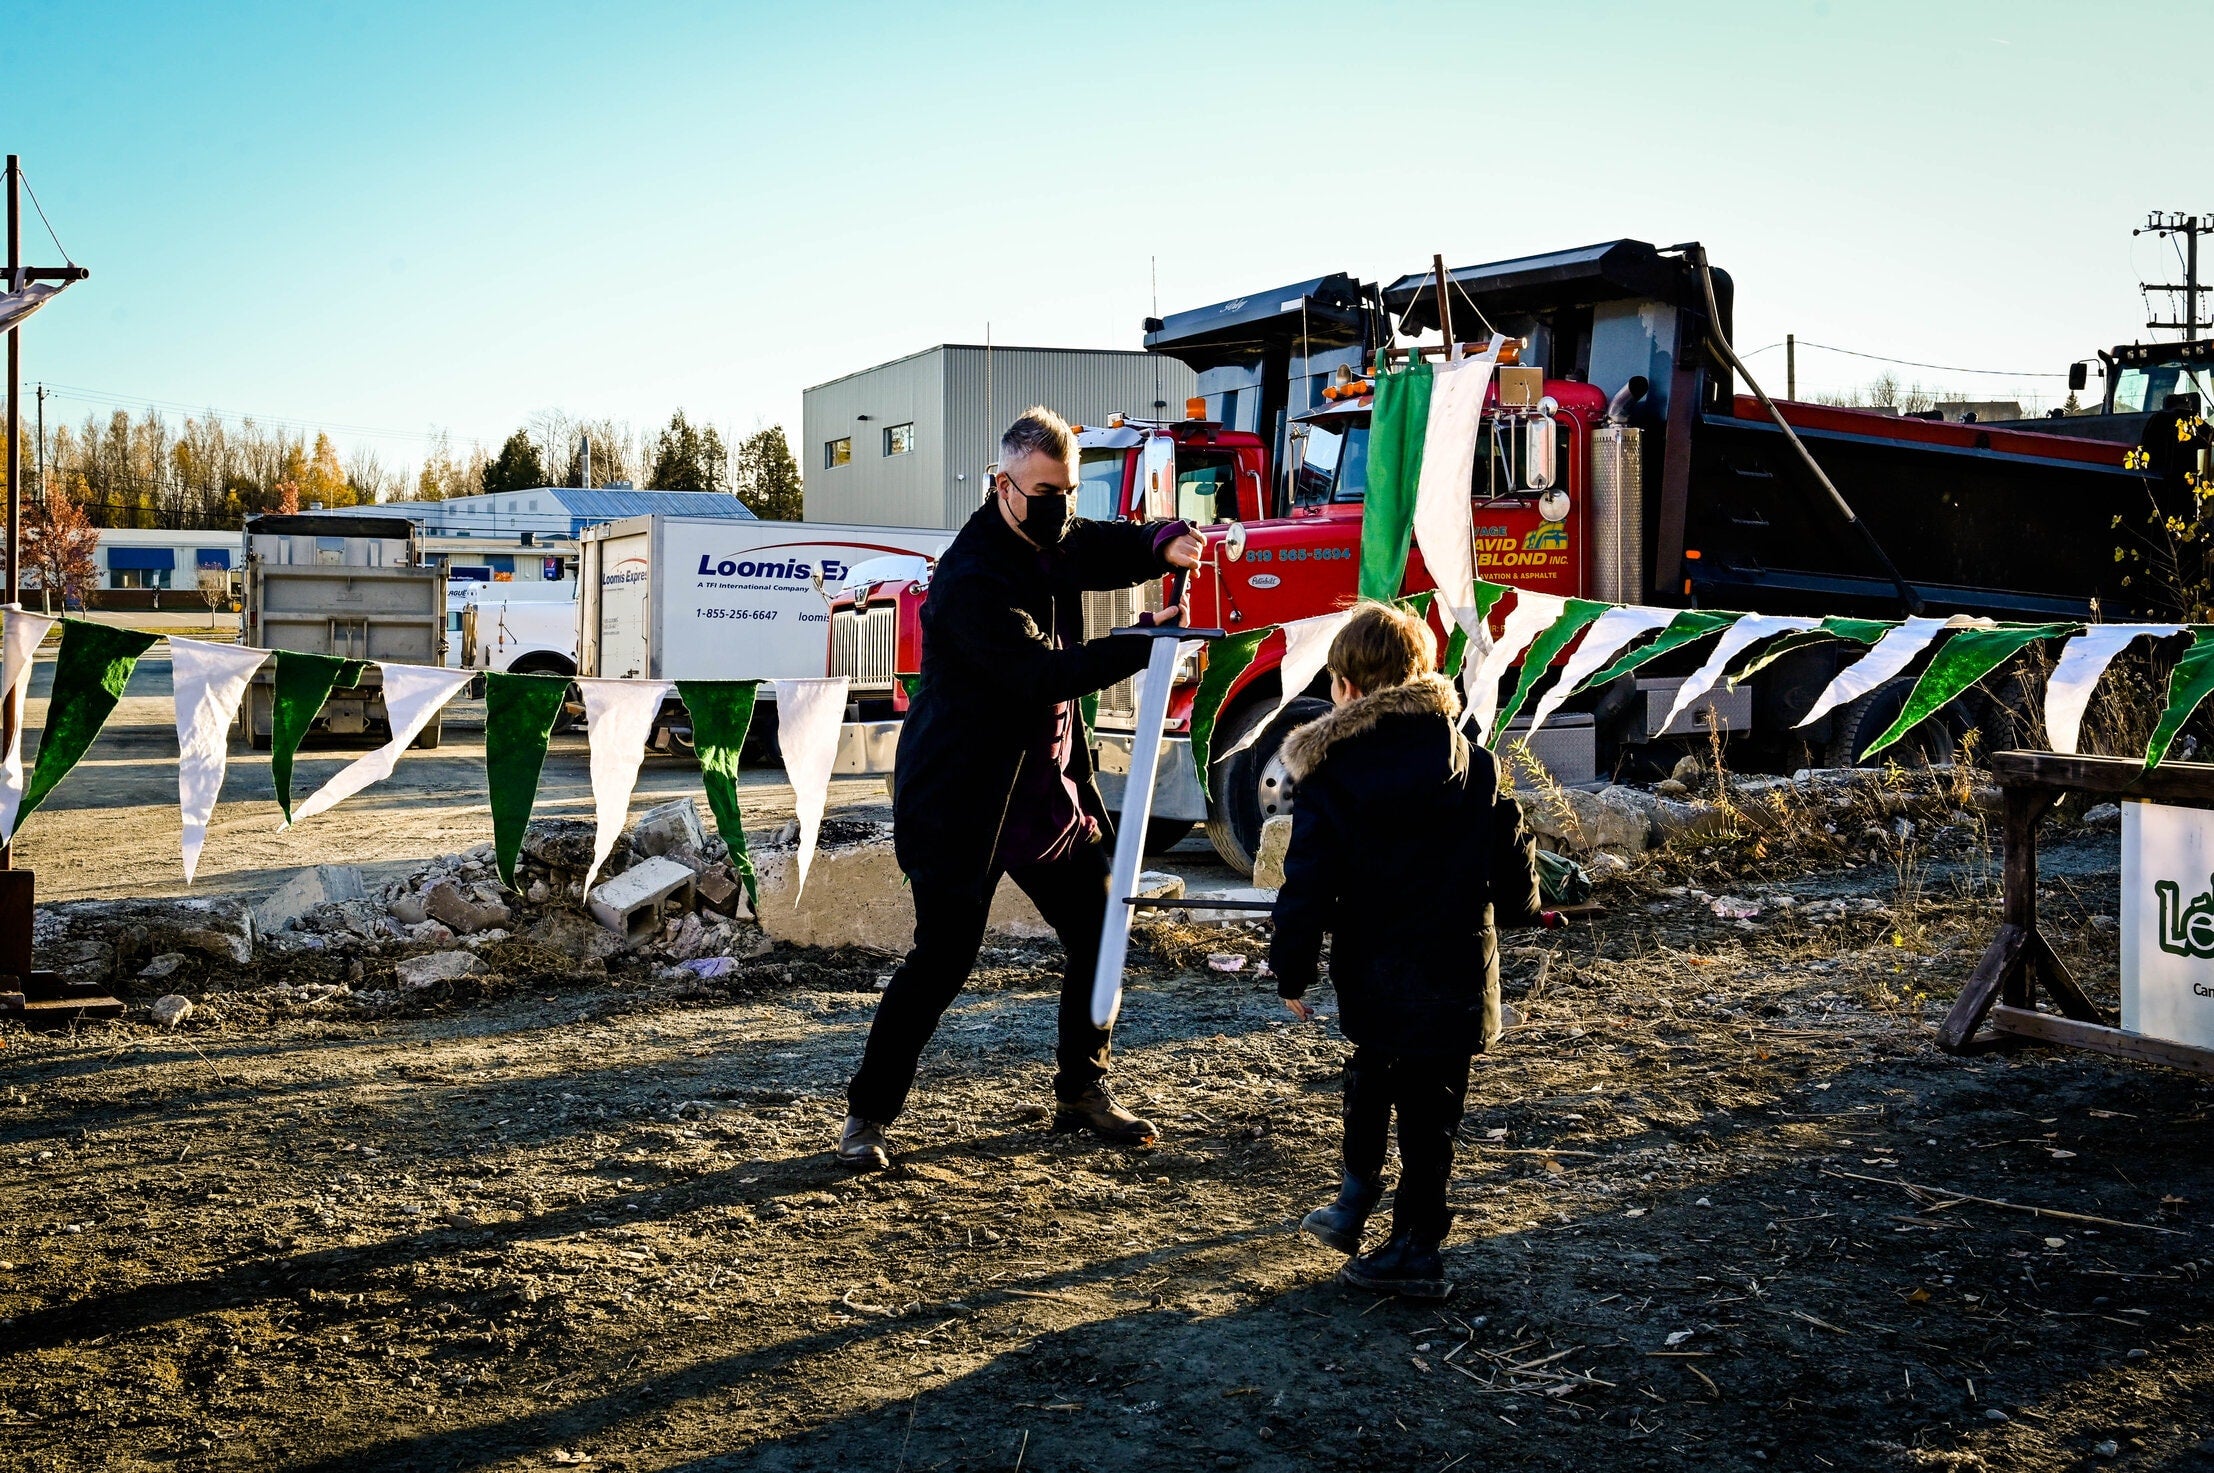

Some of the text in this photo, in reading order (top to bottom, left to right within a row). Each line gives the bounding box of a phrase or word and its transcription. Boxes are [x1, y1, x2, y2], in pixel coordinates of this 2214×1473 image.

[1474, 526, 1507, 536] VAGE
[1475, 538, 1517, 551] AVID
[1245, 548, 1351, 562] 819 565-5694
[1476, 552, 1547, 566] BLOND
[698, 554, 850, 581] Loomis Ex
[602, 569, 648, 585] Loomis Expres
[1480, 572, 1511, 580] AVATION
[719, 583, 772, 591] International
[773, 585, 810, 593] Company
[696, 608, 778, 621] 1-855-256-6647
